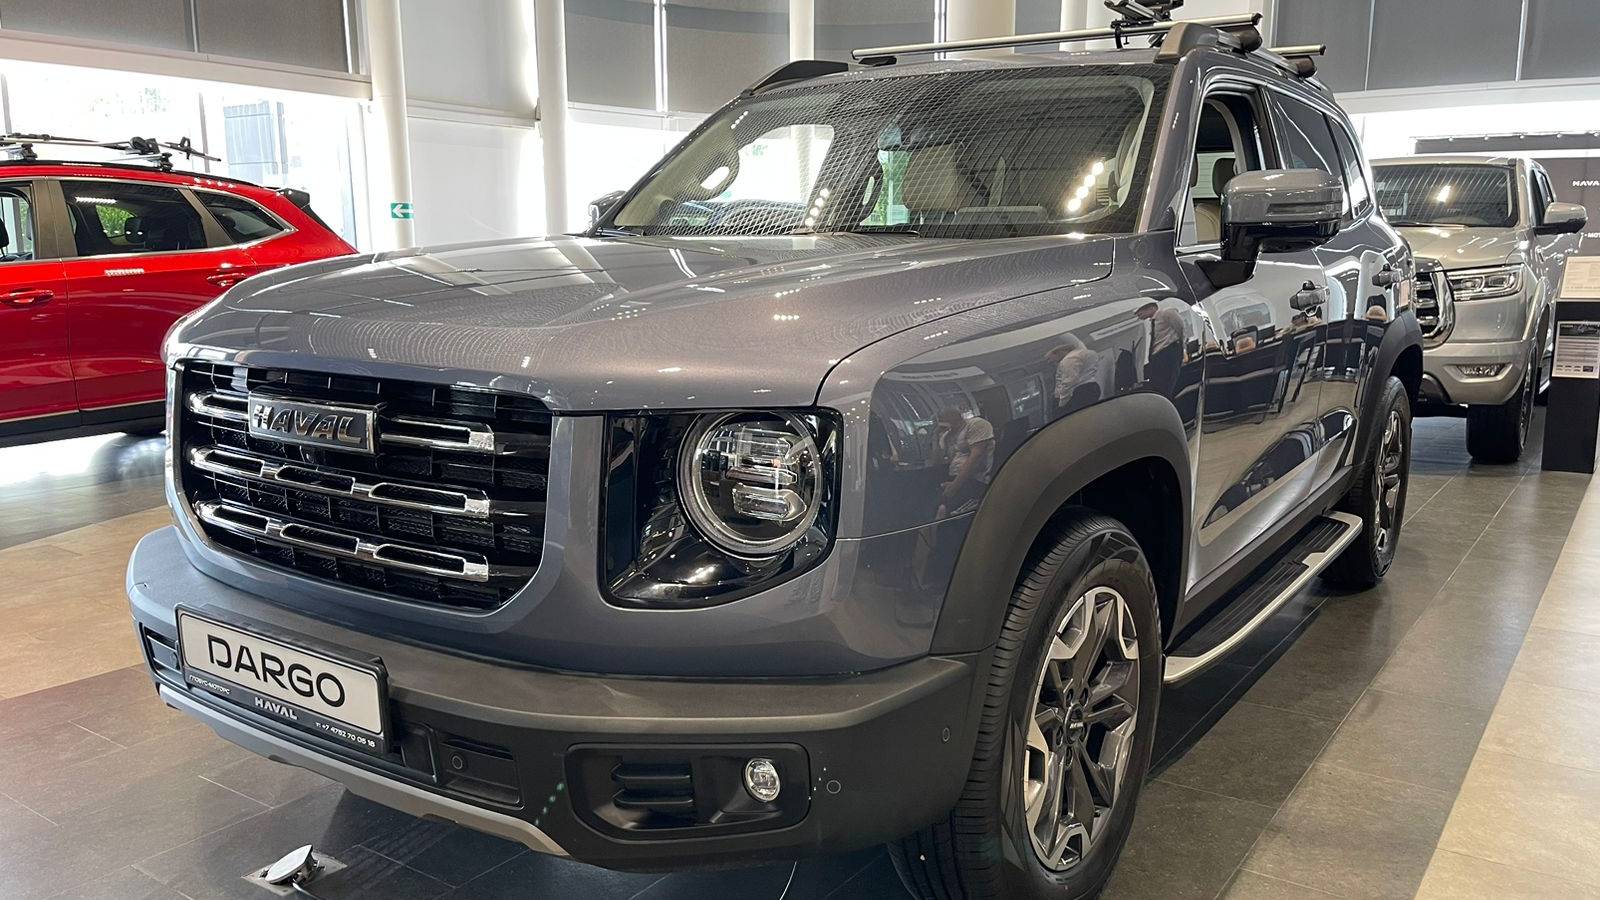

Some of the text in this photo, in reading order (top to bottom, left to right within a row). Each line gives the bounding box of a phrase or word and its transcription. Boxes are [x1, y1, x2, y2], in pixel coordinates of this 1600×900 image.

[253, 403, 362, 444] HAVAL
[208, 634, 346, 707] DARGO
[255, 697, 298, 721] HAVAL
[347, 732, 356, 741] 70
